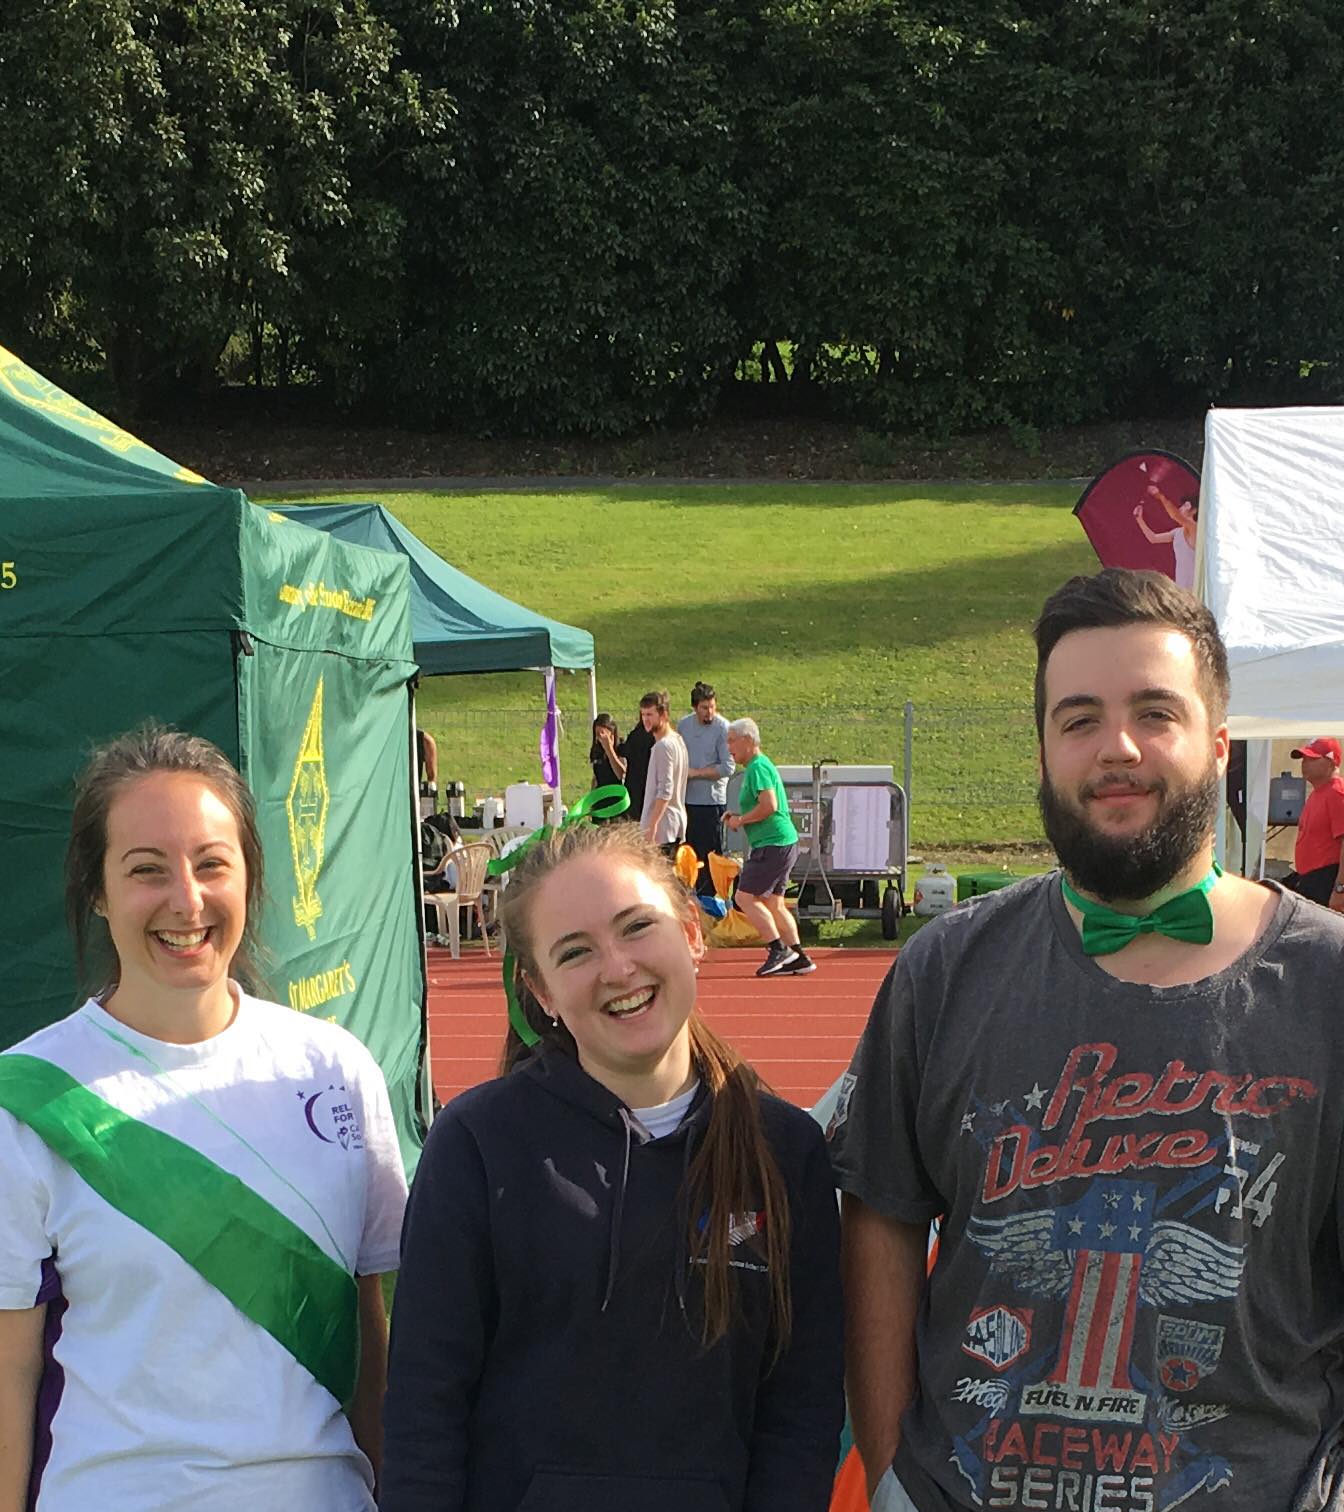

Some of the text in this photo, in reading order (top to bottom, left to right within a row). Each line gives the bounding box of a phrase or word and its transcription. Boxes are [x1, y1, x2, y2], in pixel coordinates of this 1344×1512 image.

[1041, 1042, 1318, 1131] Retro
[981, 1123, 1218, 1204] Deluxe
[1024, 1389, 1072, 1410] FUEL
[1096, 1398, 1140, 1416] FIRE
